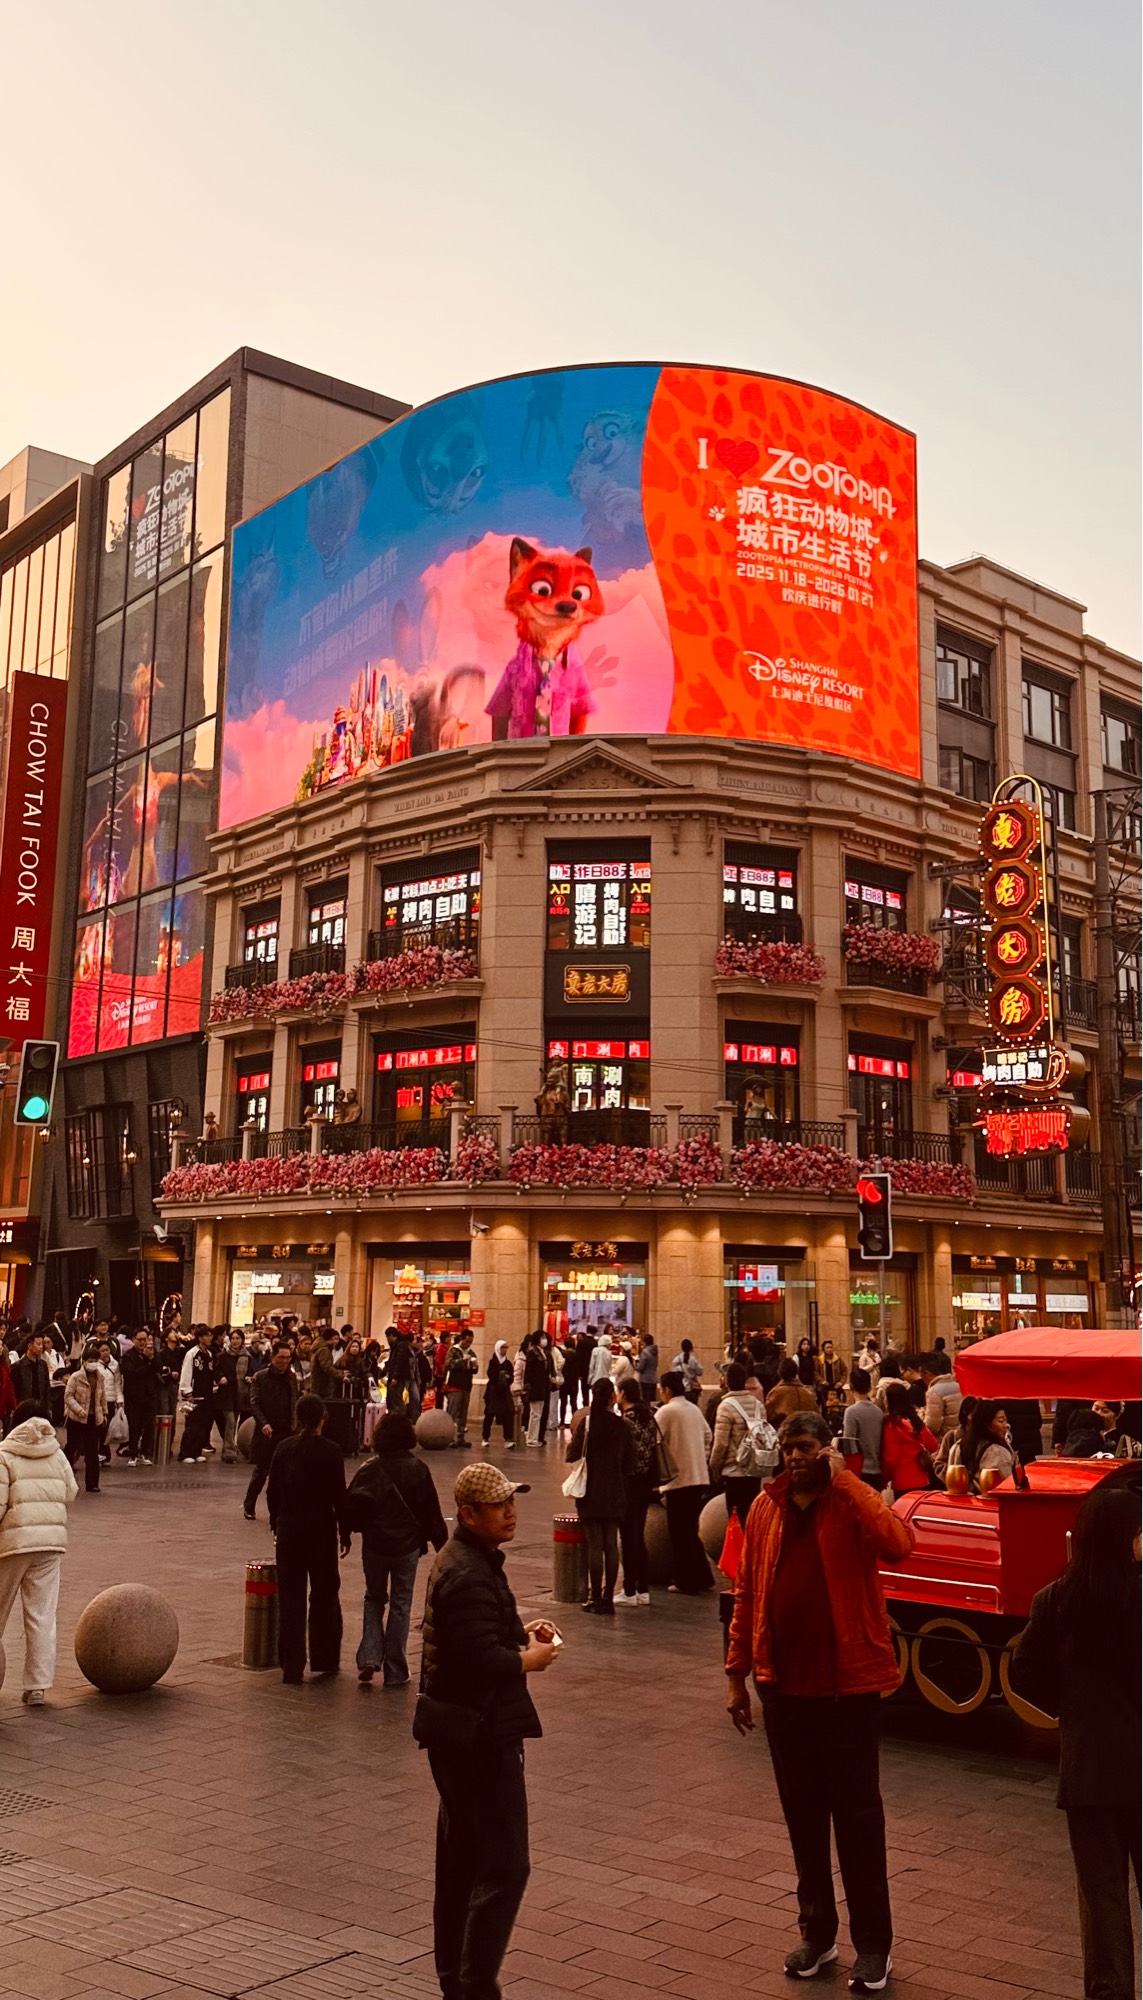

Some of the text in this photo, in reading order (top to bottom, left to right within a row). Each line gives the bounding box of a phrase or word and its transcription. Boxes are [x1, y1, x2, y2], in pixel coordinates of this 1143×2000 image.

[145, 462, 195, 514] ZOOTOPI
[698, 437, 897, 520] I ZOOTOPIA
[736, 486, 881, 550] 疯狂动物城
[736, 518, 873, 579] 城市生活节
[737, 550, 784, 565] ZOOTOPIA
[844, 573, 874, 591] FESTIVAL
[782, 587, 843, 615] 欢庆进行时
[768, 685, 853, 713] 上海迪士尼度假区
[822, 679, 865, 701] RESORT
[15, 702, 50, 907] CHOW TAI FOOK
[402, 892, 467, 923] 烤肉自助
[550, 883, 571, 894] 入口
[630, 883, 651, 894] 入口
[603, 883, 620, 945] 烤肉自助
[991, 813, 1022, 1025] 真老大房
[4, 926, 37, 1022] 周大福
[565, 970, 628, 996] 真老大房
[574, 1066, 594, 1108] 南门
